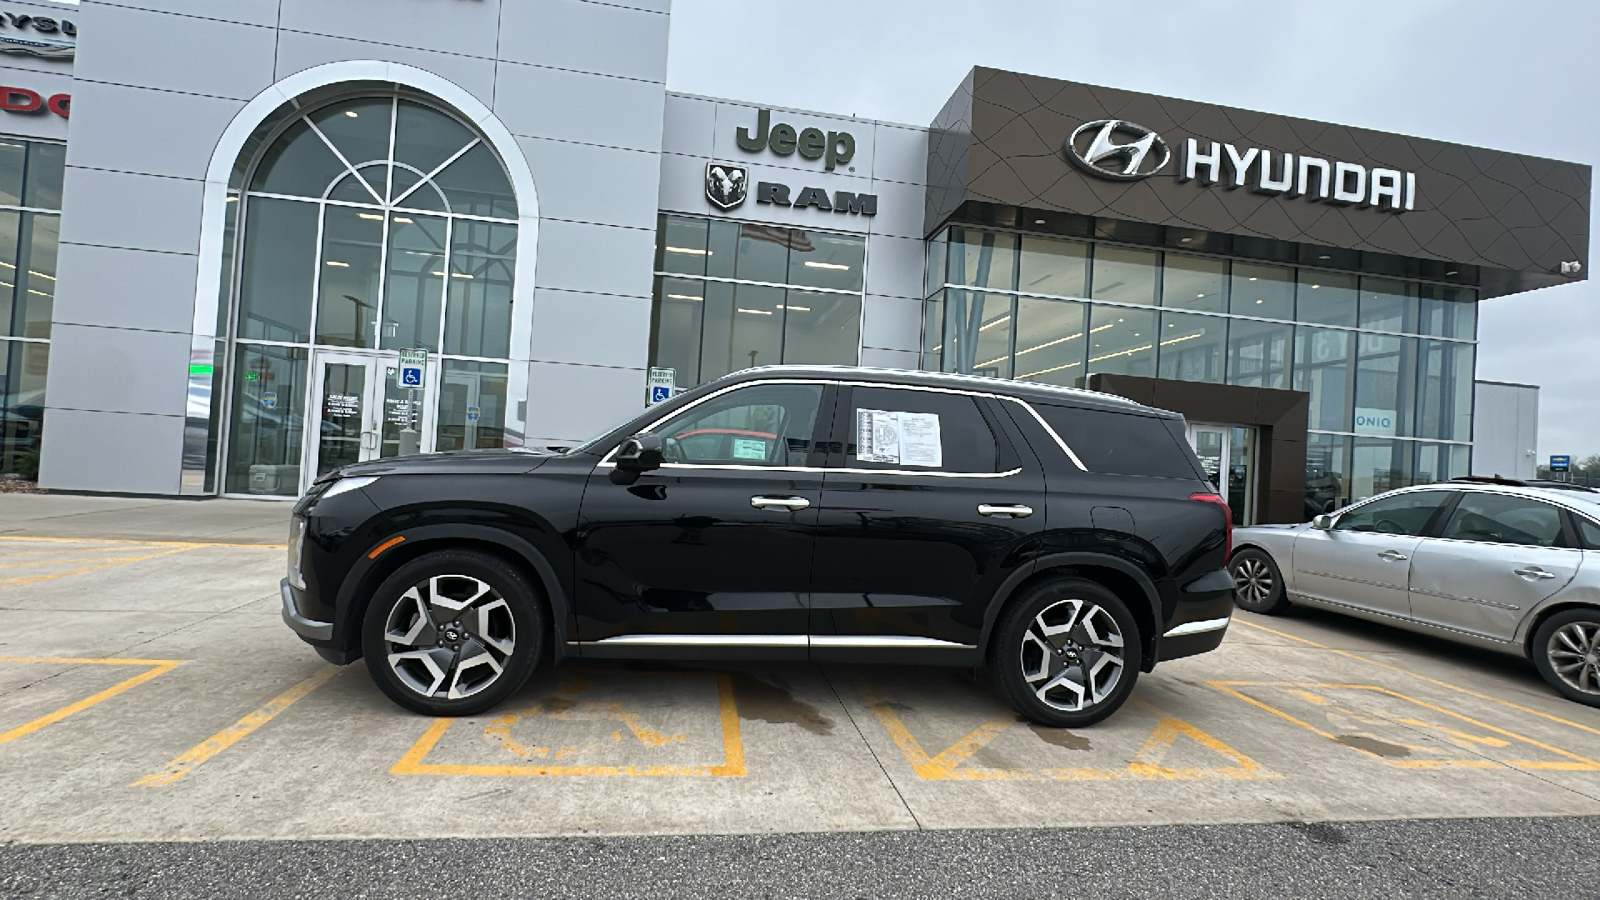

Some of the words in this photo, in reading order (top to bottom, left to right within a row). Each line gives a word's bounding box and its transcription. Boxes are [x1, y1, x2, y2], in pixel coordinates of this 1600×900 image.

[736, 109, 856, 171] Jeep
[757, 181, 878, 216] RAM
[1180, 138, 1415, 212] HYUNDAI
[1356, 416, 1391, 428] ONIQ
